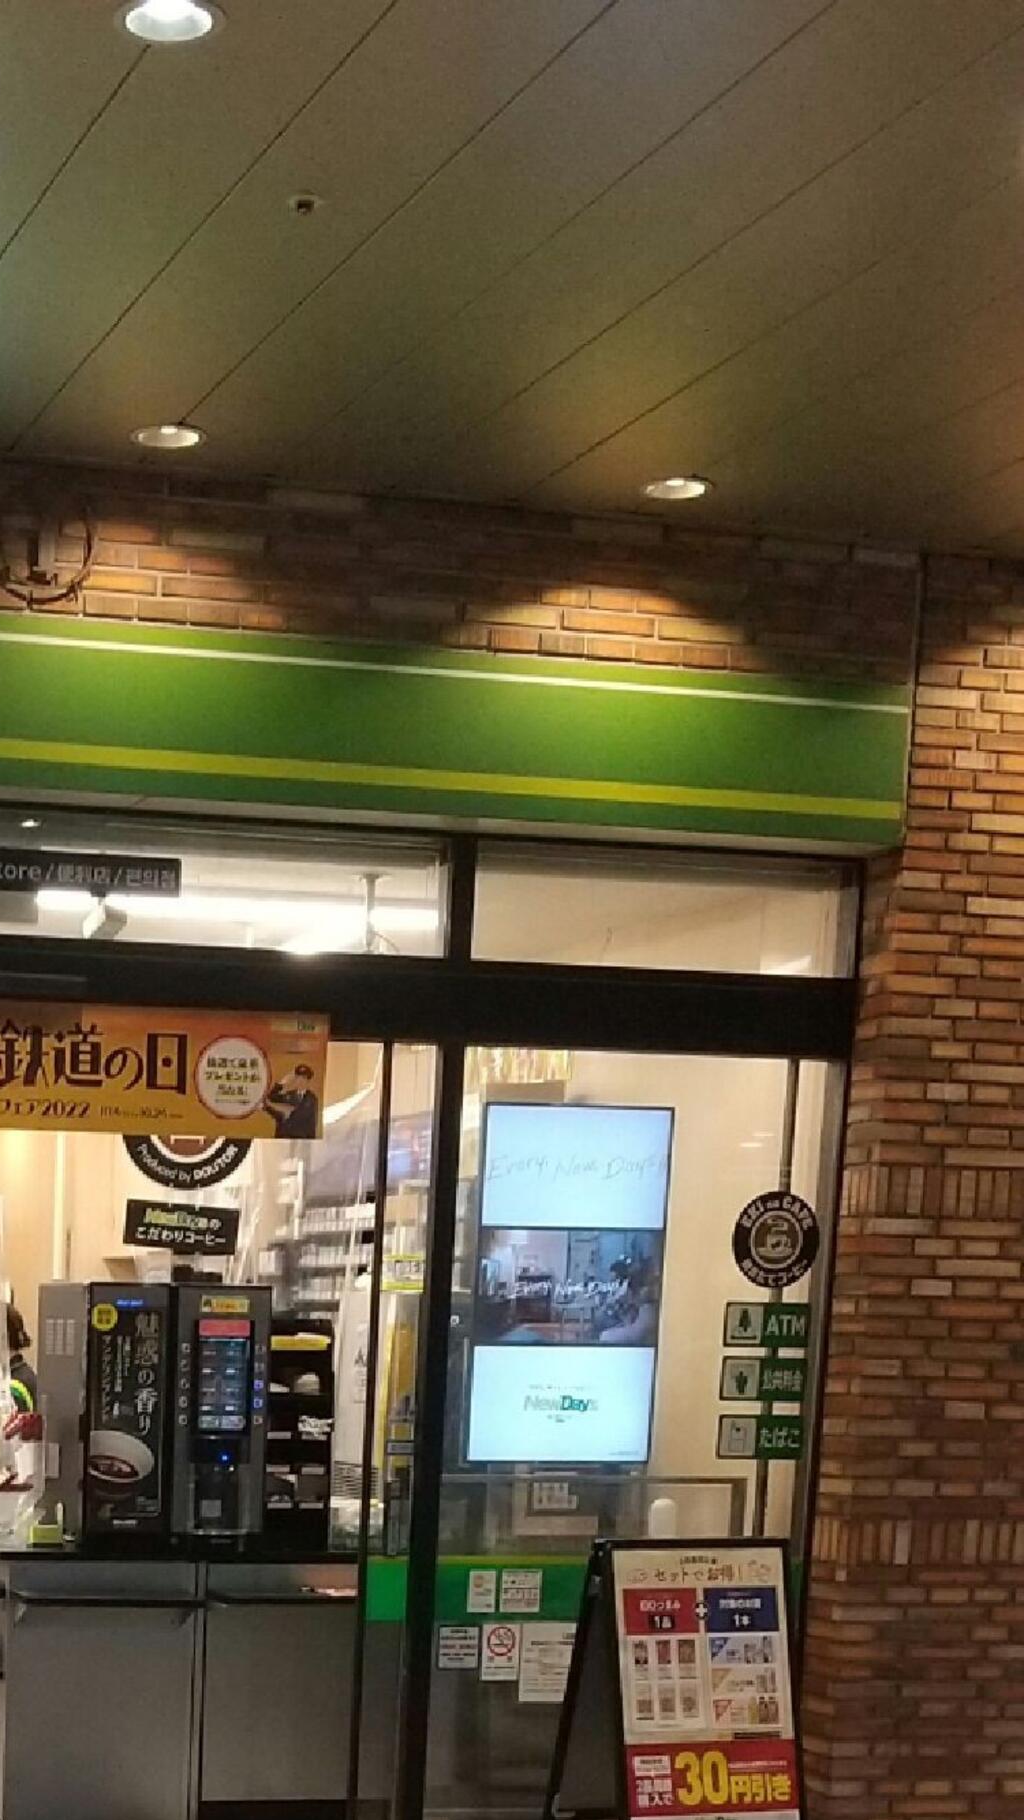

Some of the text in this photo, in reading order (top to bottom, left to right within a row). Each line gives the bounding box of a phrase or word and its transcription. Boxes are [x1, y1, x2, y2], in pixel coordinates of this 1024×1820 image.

[136, 1226, 226, 1246] こだわりコーヒー
[766, 1314, 806, 1337] ATM
[524, 1395, 599, 1412] NewDays
[759, 1426, 800, 1449] たばこ
